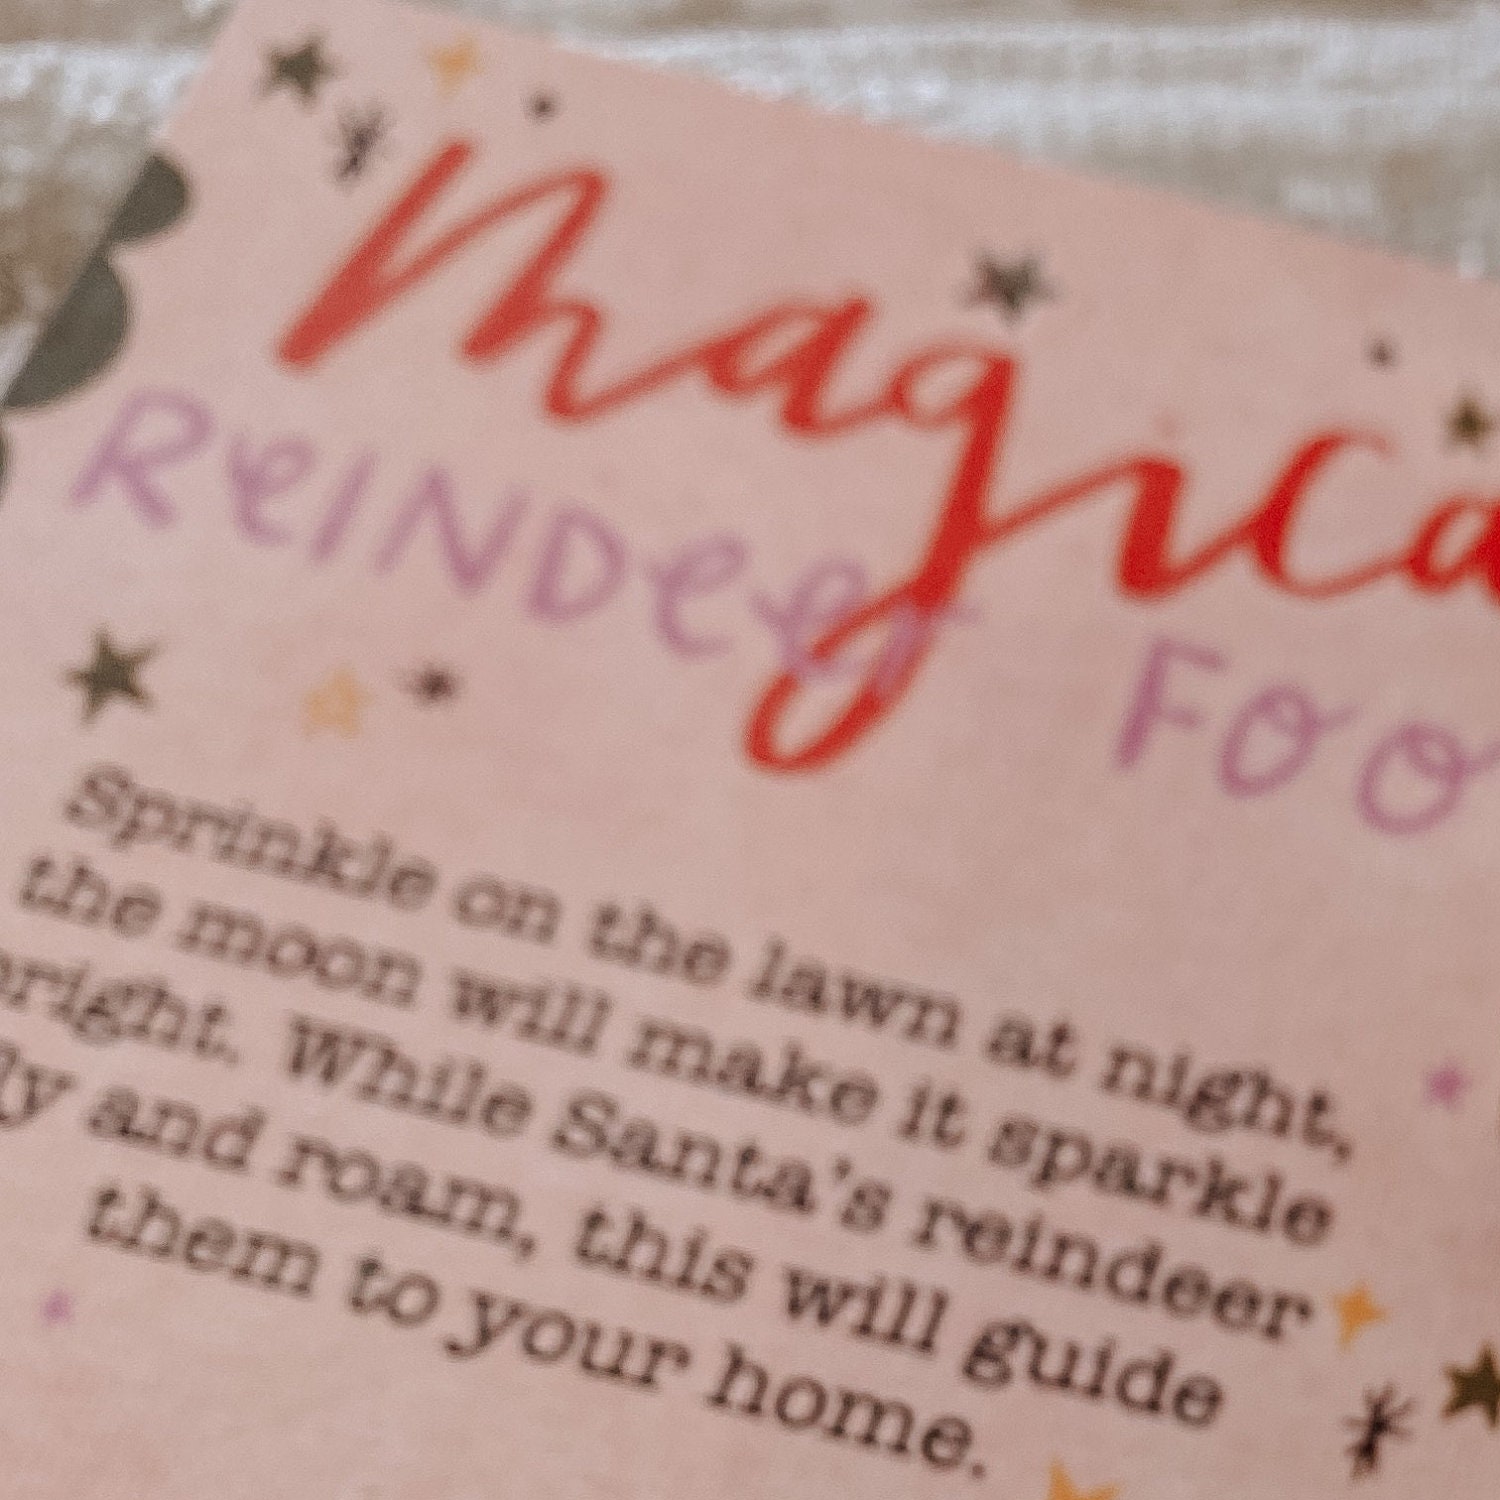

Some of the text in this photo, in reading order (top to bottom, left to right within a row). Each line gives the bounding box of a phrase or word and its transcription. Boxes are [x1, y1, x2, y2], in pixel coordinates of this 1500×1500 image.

[20, 853, 1335, 1248] the moon will make it sparkle
[65, 763, 1353, 1166] Sprinkle on the lawn at night,
[87, 1085, 268, 1172] and
[277, 1132, 538, 1262] roam,
[574, 1205, 756, 1303] this
[781, 1262, 950, 1357] will
[962, 1316, 1224, 1432] guide
[87, 1182, 988, 1484] them to your home.
[287, 1012, 533, 1139] While
[548, 1090, 893, 1234] Santa's
[912, 1196, 1314, 1342] reindeer
